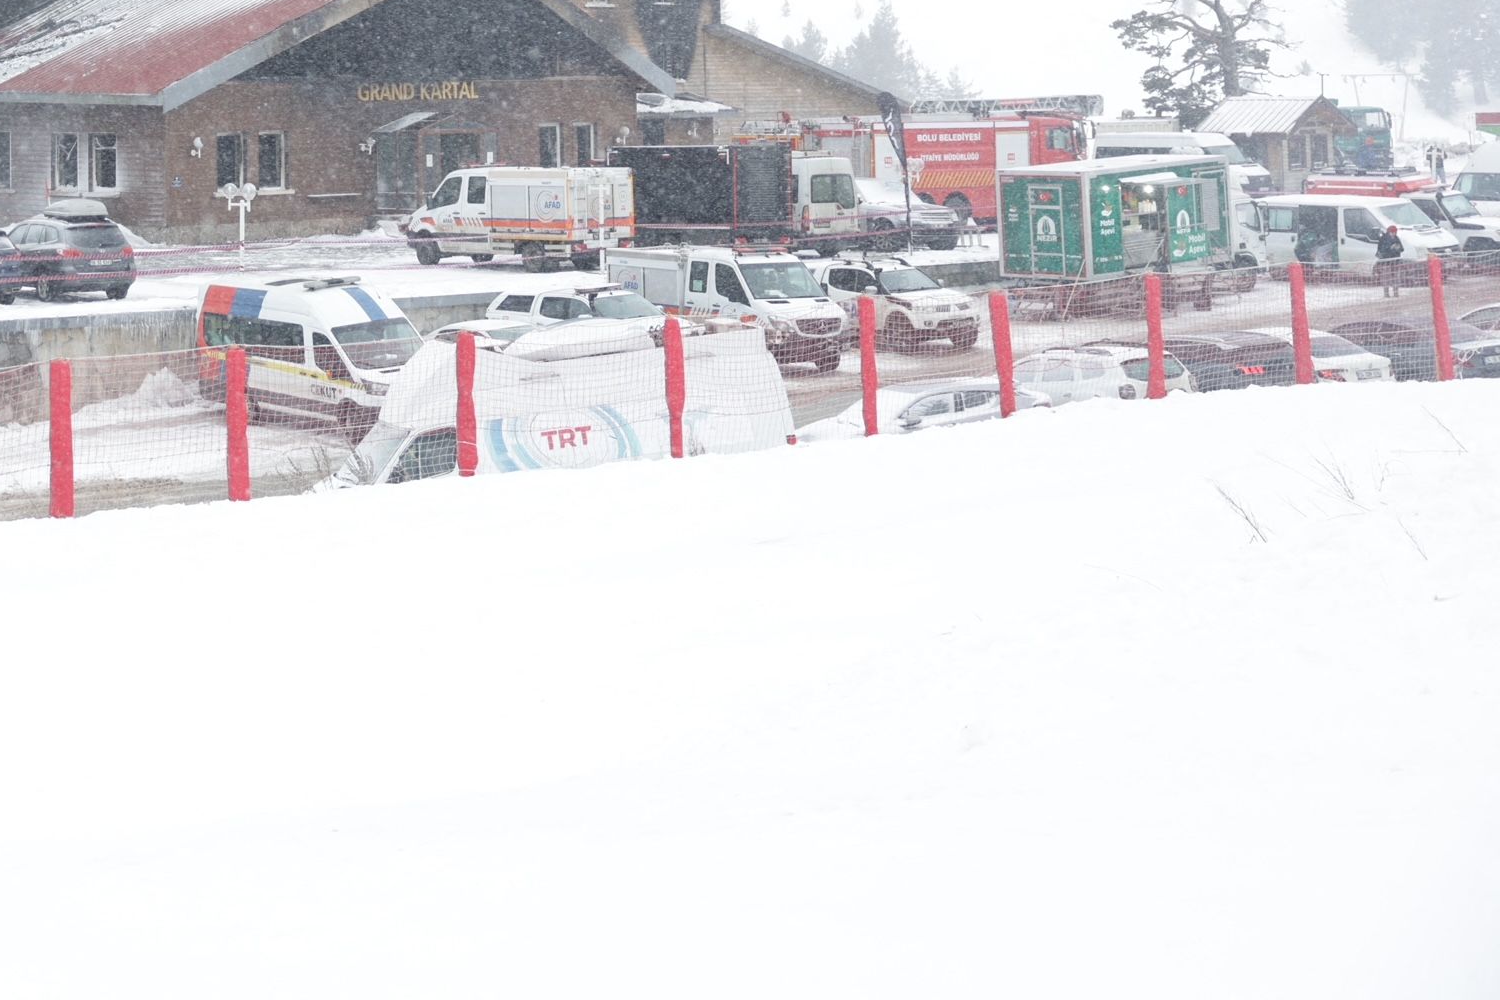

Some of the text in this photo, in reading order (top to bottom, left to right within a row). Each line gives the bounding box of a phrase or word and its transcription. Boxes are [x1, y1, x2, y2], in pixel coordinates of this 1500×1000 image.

[357, 80, 480, 102] GRAND KARTAL
[916, 131, 981, 142] BOLU BELEDİYESİ
[544, 201, 561, 209] AFAD
[1188, 233, 1206, 243] Mobil
[623, 280, 639, 290] AFAD
[540, 425, 591, 450] TRT
